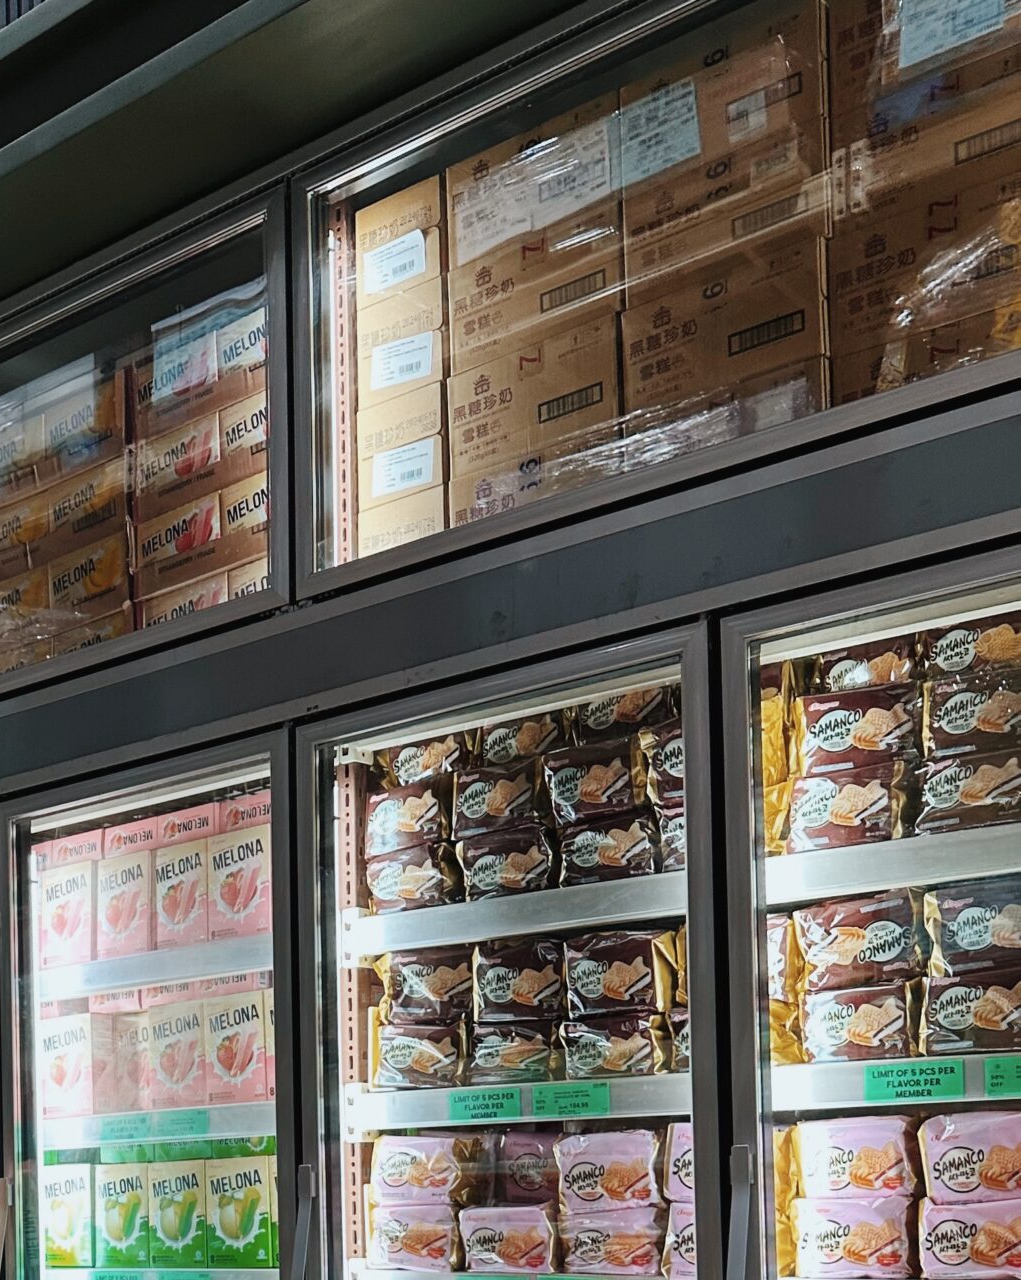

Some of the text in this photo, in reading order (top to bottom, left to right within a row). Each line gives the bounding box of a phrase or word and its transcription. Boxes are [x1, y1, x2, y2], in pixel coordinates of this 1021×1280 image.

[49, 405, 93, 444] MELONA
[54, 483, 95, 522] MELONA
[142, 518, 189, 558] MELONA
[53, 559, 96, 596] MELONA
[930, 630, 979, 663] SAMANCO
[809, 710, 861, 739] SAMANCO
[483, 726, 518, 757] SAMANCO
[457, 781, 494, 810] SAMANCO
[155, 853, 202, 884] MELONA
[213, 838, 264, 871] MELONA
[46, 873, 88, 903] MELONA
[99, 864, 143, 894] MELONA
[946, 906, 998, 940] SAMANCO
[859, 928, 912, 963] SAMANCO
[570, 961, 607, 986] SAMANCO
[929, 987, 982, 1018] SAMANCO
[152, 1013, 200, 1041] MELONA
[209, 1004, 259, 1034] MELONA
[872, 1067, 955, 1079] LIMIT OF 5 PCS PER
[887, 1078, 941, 1088] FLAVOR PER
[895, 1089, 932, 1098] MEMBER
[564, 1166, 605, 1190] SAMANCO
[933, 1150, 985, 1180] SAMANCO
[98, 1176, 144, 1199] MELONA
[152, 1174, 199, 1197] MELONA
[210, 1169, 262, 1194] MELONA
[925, 1223, 977, 1250] SAMANCO
